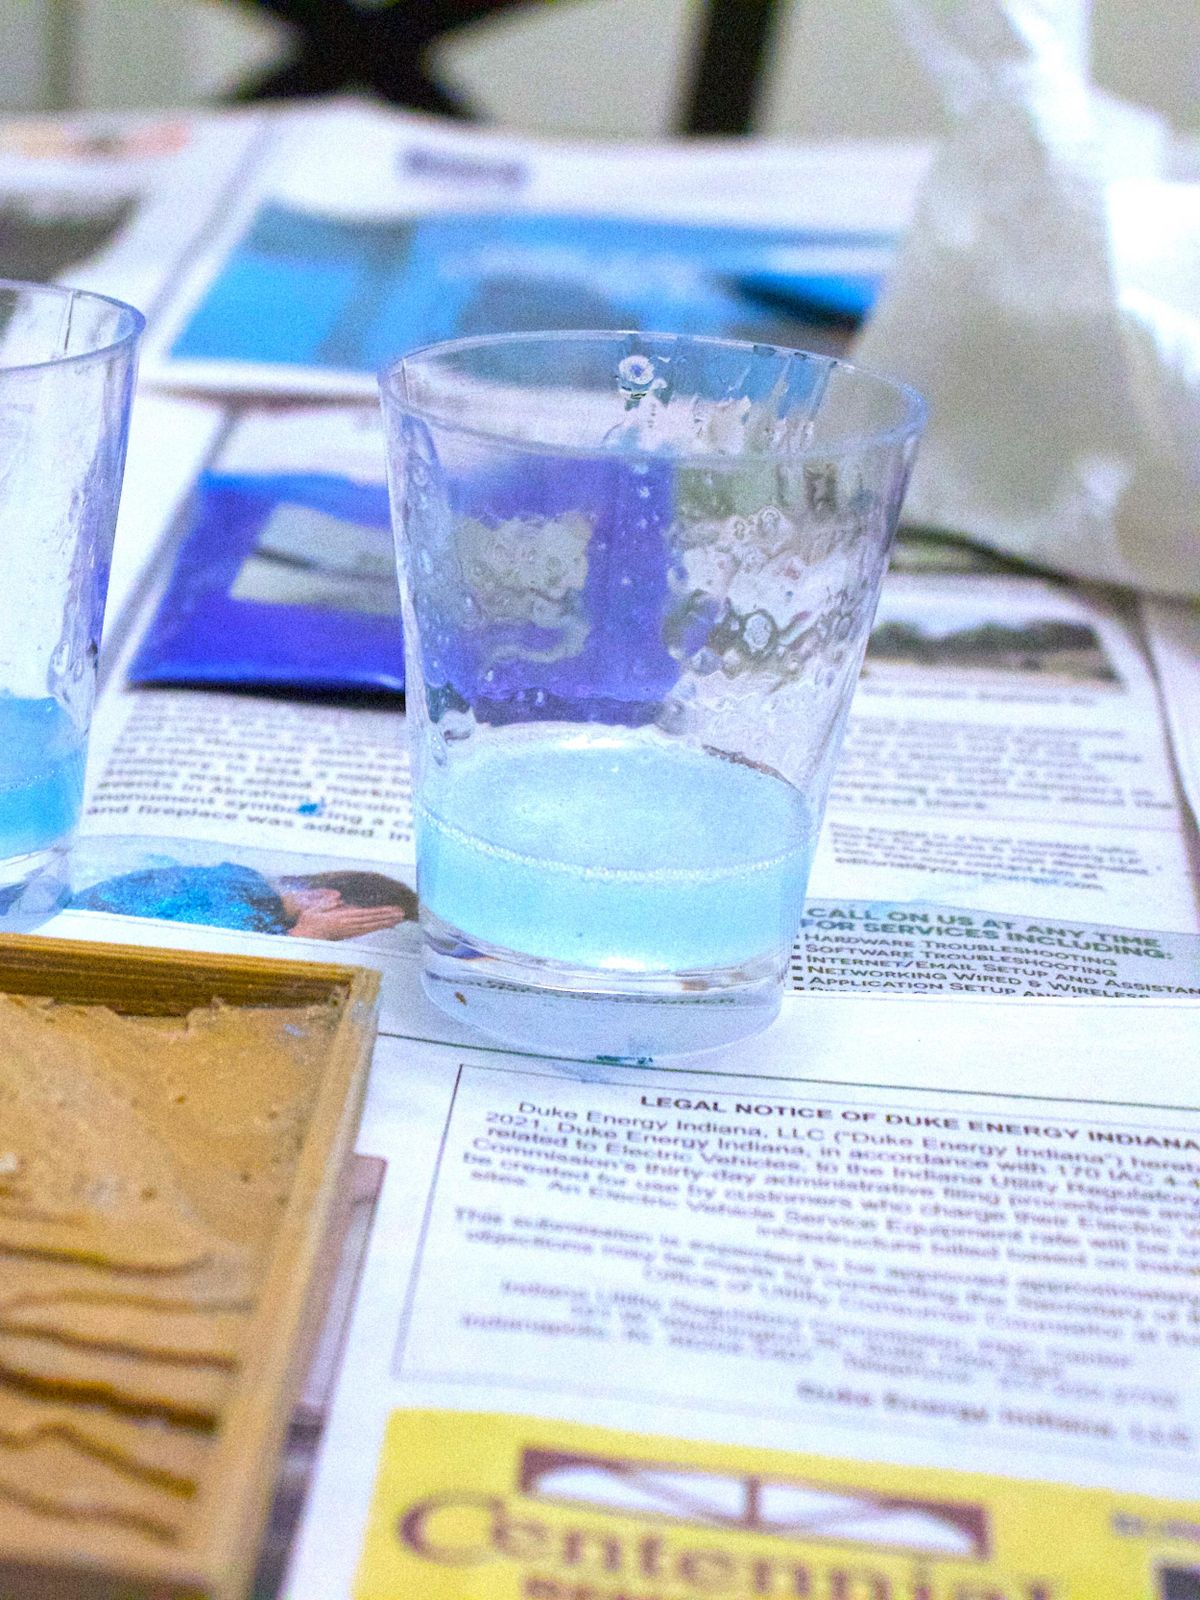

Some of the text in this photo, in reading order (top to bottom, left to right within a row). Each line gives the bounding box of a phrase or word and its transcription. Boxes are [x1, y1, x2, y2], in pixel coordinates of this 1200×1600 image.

[86, 805, 129, 816] and
[138, 804, 239, 819] fireplace
[247, 814, 294, 828] was
[801, 918, 1173, 960] FOR SERVICES INCLUDING:
[807, 908, 1161, 948] CALL ON US AT ANY TIME
[804, 933, 1118, 967] HARDWARE TROUBLESHOOTING
[805, 943, 1118, 978] SOFTWARE TROUBLESHOOTING
[808, 966, 948, 980] NETWORKING
[953, 972, 1022, 986] WIRED
[809, 976, 944, 990] APPLICATION
[950, 982, 1016, 995] SETUP
[982, 963, 1048, 978] SETUP
[1055, 973, 1098, 985] AND
[519, 1101, 578, 1120] Duke
[586, 1110, 668, 1131] Energy
[677, 1120, 768, 1139] Indiana,
[777, 1127, 824, 1141] LLC
[922, 1137, 1008, 1158] Energy
[640, 1096, 726, 1113] LEGAL
[735, 1103, 832, 1119] NOTICE
[841, 1112, 876, 1123] OF
[885, 1114, 959, 1129] DUKE
[968, 1120, 1079, 1139] ENERGY
[488, 1127, 568, 1148] related
[575, 1140, 597, 1152] to
[606, 1142, 693, 1162] Electric
[816, 1162, 839, 1174] to
[847, 1163, 884, 1176] the
[893, 1166, 982, 1185] Indiana
[558, 1121, 617, 1139] Duke
[626, 1130, 709, 1150] Energy
[820, 1147, 841, 1158] in
[849, 1150, 989, 1169] accordance
[997, 1160, 1047, 1175] with
